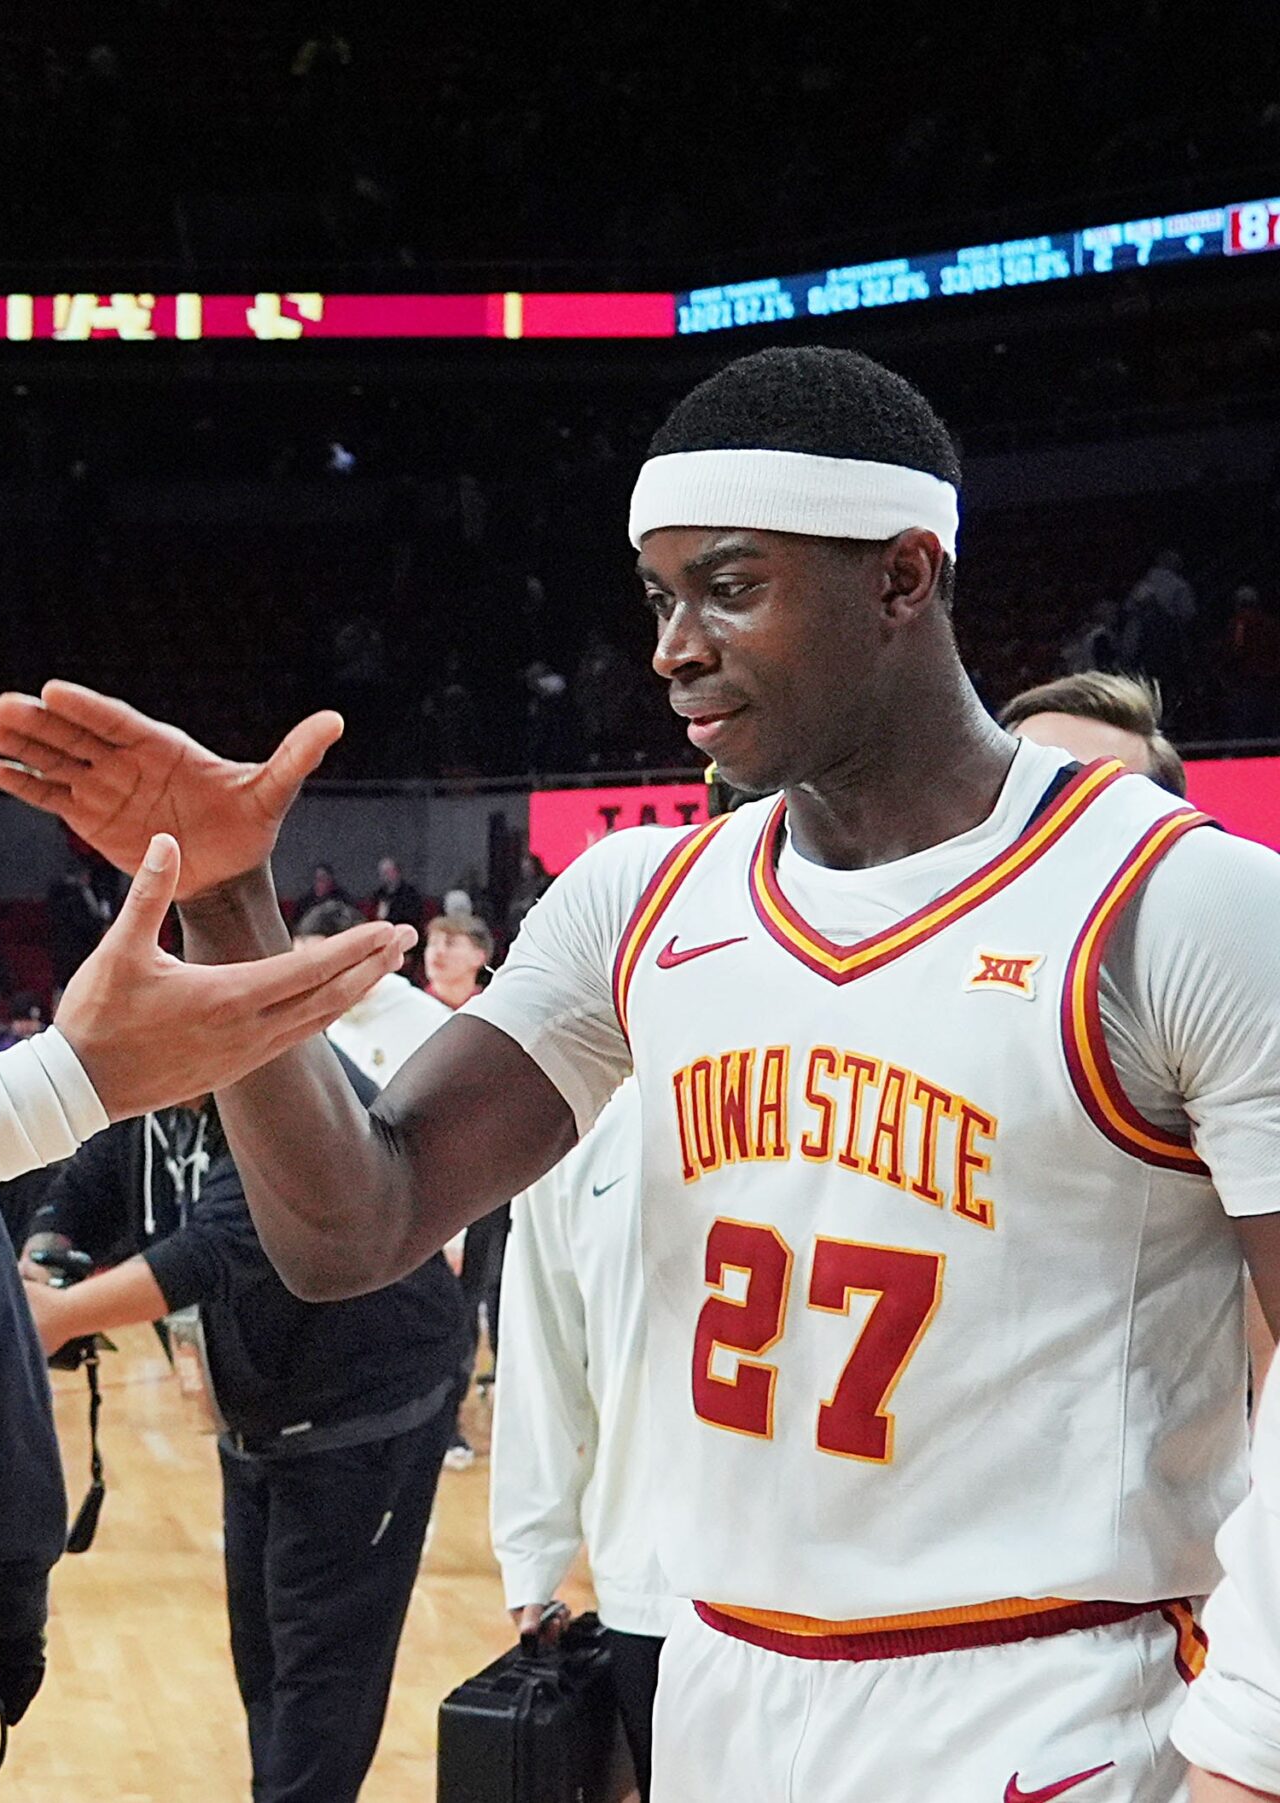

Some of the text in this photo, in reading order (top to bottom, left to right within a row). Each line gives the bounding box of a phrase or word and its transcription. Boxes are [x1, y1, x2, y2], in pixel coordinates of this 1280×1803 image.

[672, 1044, 999, 1231] IOWA STATE
[691, 1216, 946, 1465] 27
